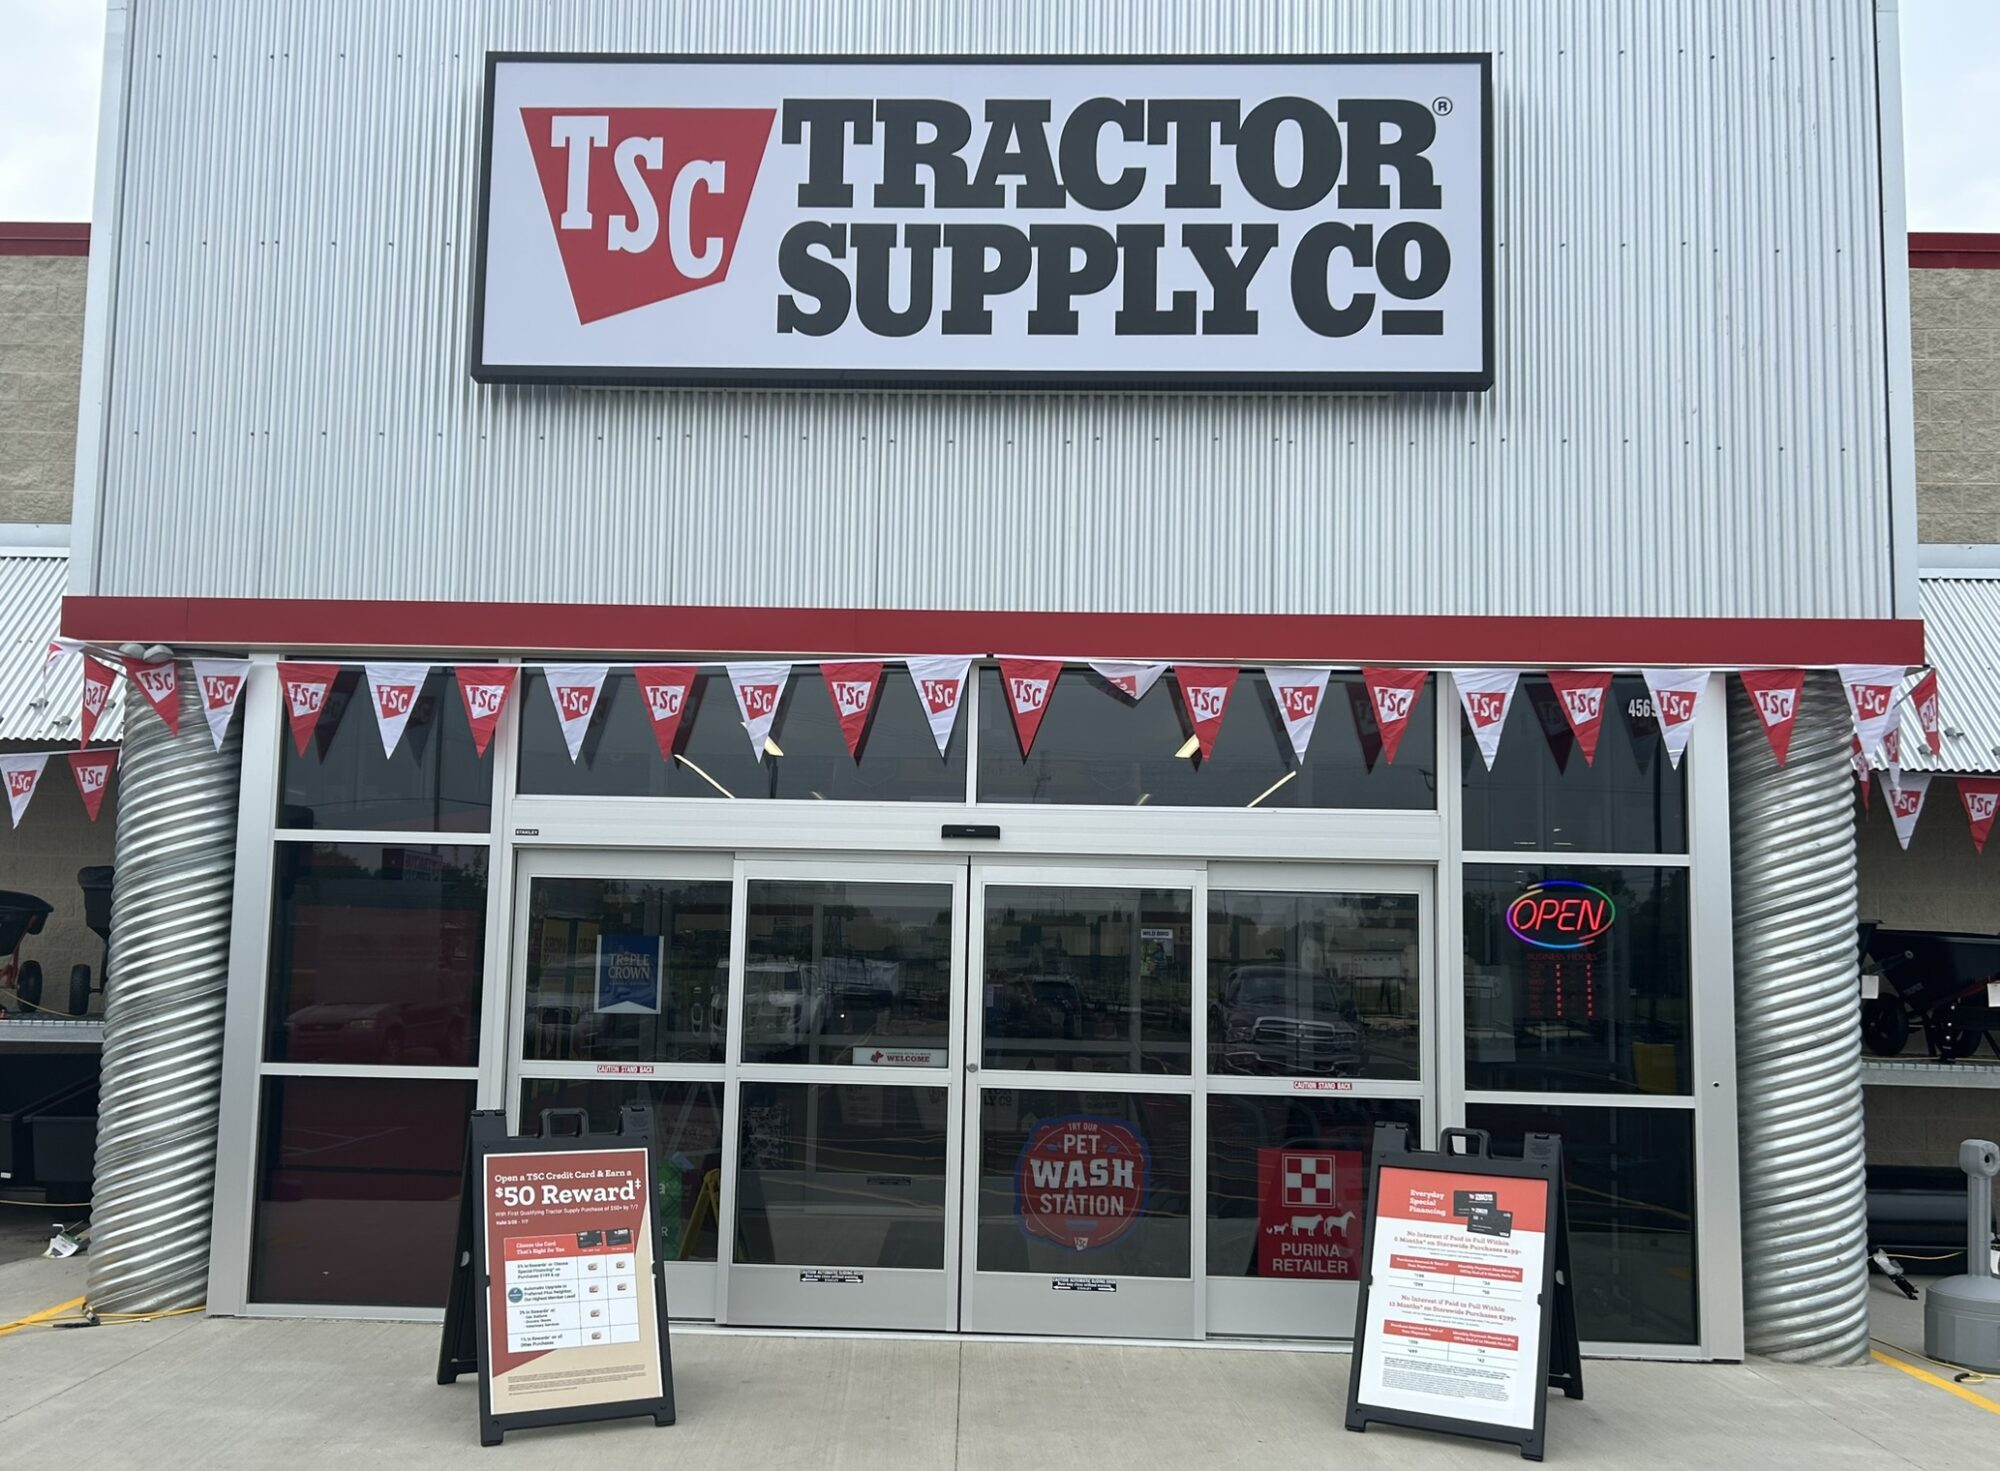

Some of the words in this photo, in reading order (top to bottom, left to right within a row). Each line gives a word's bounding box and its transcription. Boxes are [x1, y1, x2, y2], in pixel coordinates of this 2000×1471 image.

[780, 96, 1442, 211] TRACTOR
[551, 114, 725, 279] TSC
[777, 220, 1279, 337] SUPPLY
[142, 671, 174, 692] TSC
[206, 676, 235, 701] TSC
[924, 680, 953, 708] TSC
[1013, 680, 1042, 707] TSC
[291, 684, 319, 711] TSC
[380, 686, 408, 713] TSC
[469, 687, 498, 712] TSC
[560, 687, 589, 714] TSC
[649, 687, 678, 713] TSC
[743, 687, 772, 713] TSC
[836, 682, 865, 710] TSC
[1191, 688, 1220, 716] TSC
[1284, 688, 1313, 714] TSC
[1378, 688, 1407, 718] TSC
[1471, 694, 1499, 722] TSC
[1567, 689, 1598, 717] TSC
[1660, 691, 1690, 720] TSC
[1760, 691, 1791, 719] TSC
[1855, 685, 1885, 715] TSC
[9, 771, 32, 792] TSC
[79, 767, 104, 787] TSC
[1969, 793, 1993, 815] TSC
[1513, 899, 1605, 931] OPEN
[608, 967, 650, 979] CROWN
[598, 1064, 619, 1073] CAUTION
[621, 1065, 638, 1073] STAND
[887, 1055, 931, 1063] WELCOME
[1294, 1081, 1317, 1089] CAUTION
[1318, 1082, 1336, 1090] STAND
[1083, 1122, 1098, 1132] OUR
[1063, 1133, 1101, 1155] PET
[494, 1174, 518, 1183] Open
[526, 1173, 545, 1181] TSC
[546, 1172, 574, 1180] Credit
[574, 1171, 595, 1179] Card
[1030, 1158, 1134, 1189] WASH
[495, 1185, 535, 1207] $50
[1040, 1193, 1124, 1217] STATION
[1409, 1198, 1436, 1207] Special
[1410, 1189, 1445, 1200] Everyday
[1408, 1205, 1447, 1217] Financing
[1281, 1242, 1340, 1258] PURINA
[1417, 1232, 1442, 1240] Interest
[1487, 1238, 1509, 1246] Within
[1437, 1241, 1468, 1249] Storewide
[1470, 1244, 1503, 1253] Purchases
[1272, 1258, 1348, 1274] RETAILER
[1411, 1295, 1437, 1304] Interest
[1482, 1304, 1505, 1312] Within
[1433, 1306, 1464, 1315] Storewide
[1465, 1310, 1497, 1319] Purchases
